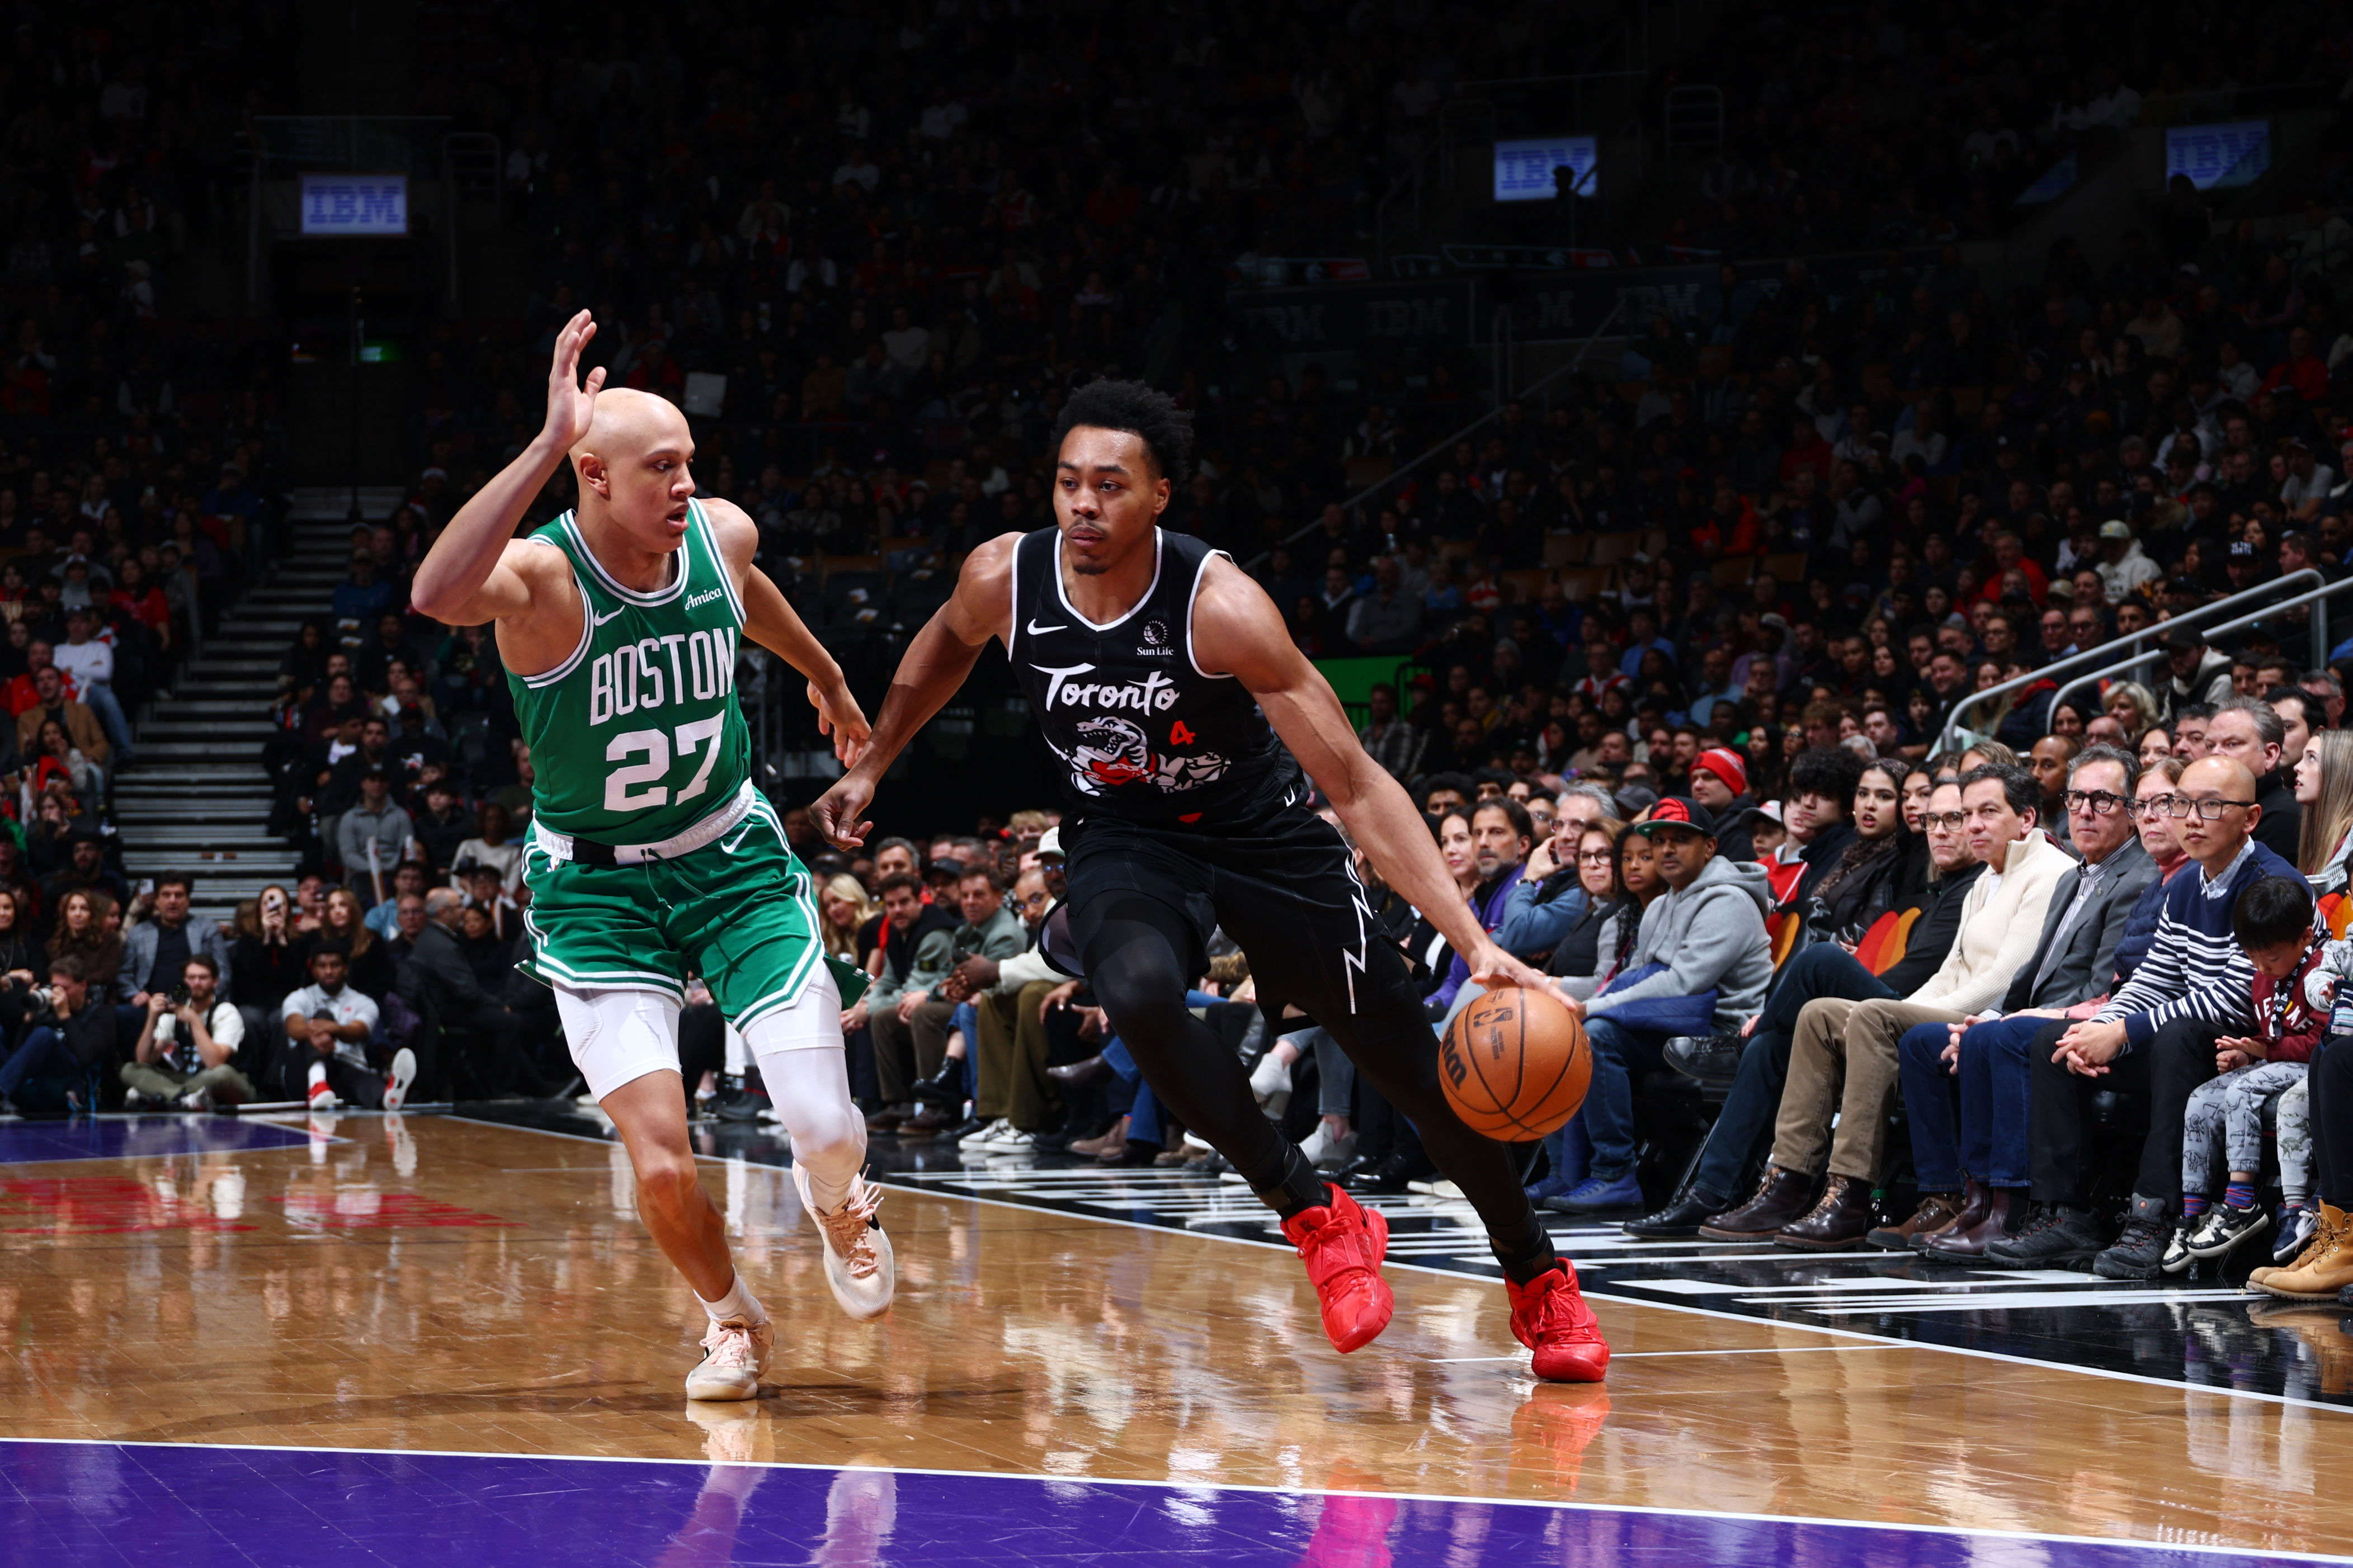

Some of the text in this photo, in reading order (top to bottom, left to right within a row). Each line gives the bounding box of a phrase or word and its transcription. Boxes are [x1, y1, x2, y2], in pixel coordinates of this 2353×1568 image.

[1501, 148, 1589, 189] IBM
[309, 186, 400, 224] IBM
[1365, 297, 1449, 338] IBM
[685, 587, 723, 611] Amica
[1137, 646, 1174, 656] Sun Life
[590, 626, 736, 726] BOSTON
[1028, 662, 1181, 716] Toronto
[1169, 720, 1197, 747] 4
[603, 710, 725, 813] 27
